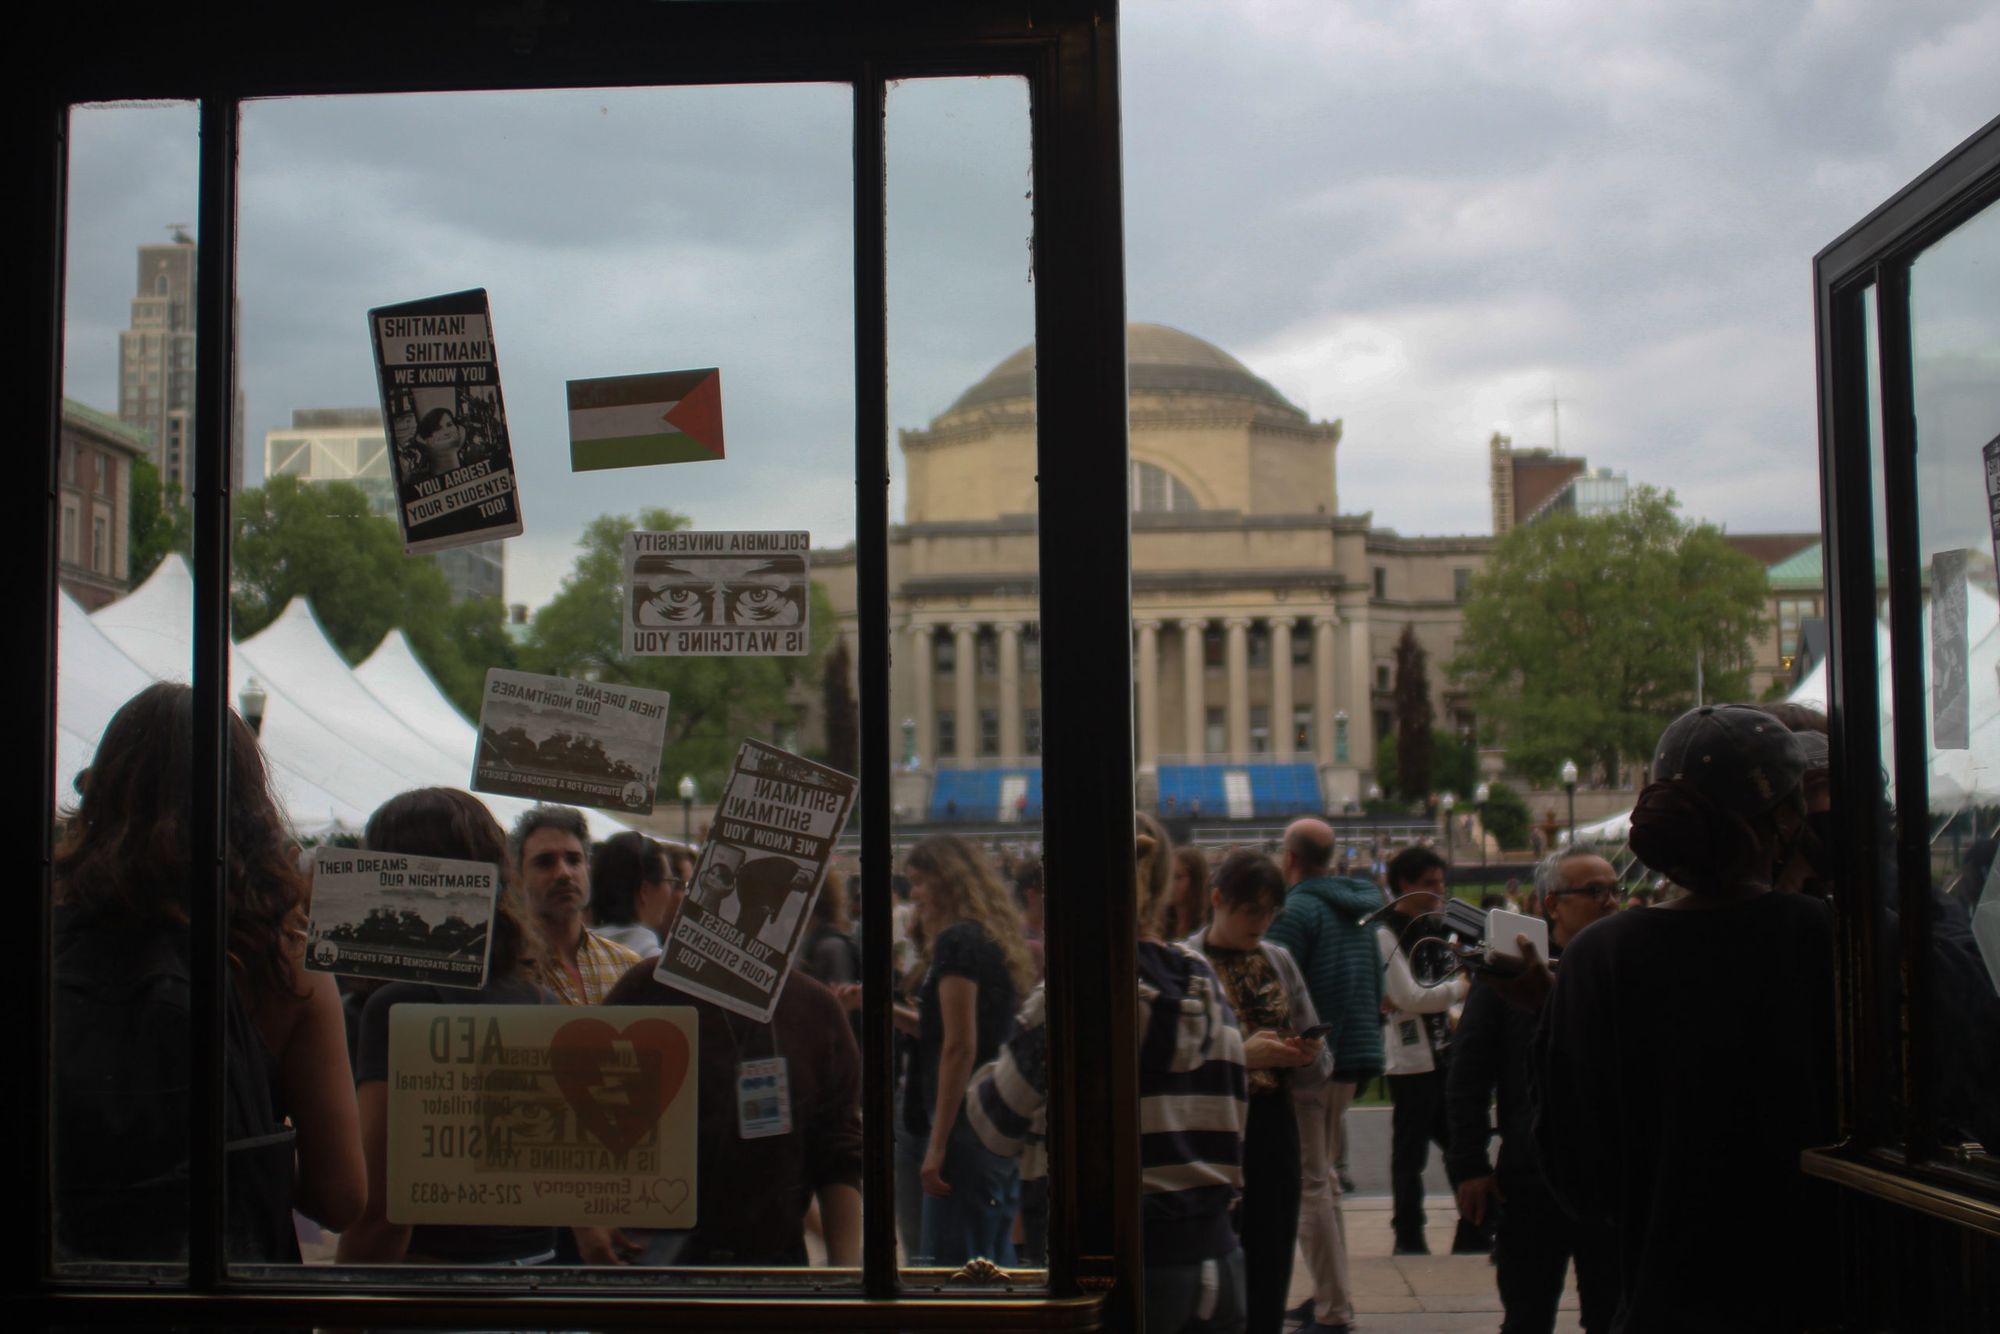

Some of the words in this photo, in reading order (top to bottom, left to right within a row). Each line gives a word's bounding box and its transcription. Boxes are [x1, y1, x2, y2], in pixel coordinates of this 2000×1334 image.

[385, 317, 465, 337] SHITMAN!
[406, 341, 487, 362] SHITMAN!
[395, 369, 414, 384] WE
[419, 367, 456, 383] KNOW
[462, 366, 486, 381] YOU
[414, 479, 441, 498] YOU
[445, 460, 492, 488] ARREST
[408, 497, 442, 521] YOUR
[447, 474, 510, 509] STUDENTS
[478, 498, 508, 518] TOO!
[318, 860, 353, 874] THEIR
[357, 858, 408, 872] DREAMS
[379, 872, 404, 886] OUR
[408, 874, 490, 888] NIGHTMARES
[339, 949, 378, 963] STUDENTS
[378, 952, 394, 964] FOR
[395, 955, 401, 965] A
[402, 956, 449, 971] DEMOCRATIC
[451, 962, 483, 975] SOCIETY
